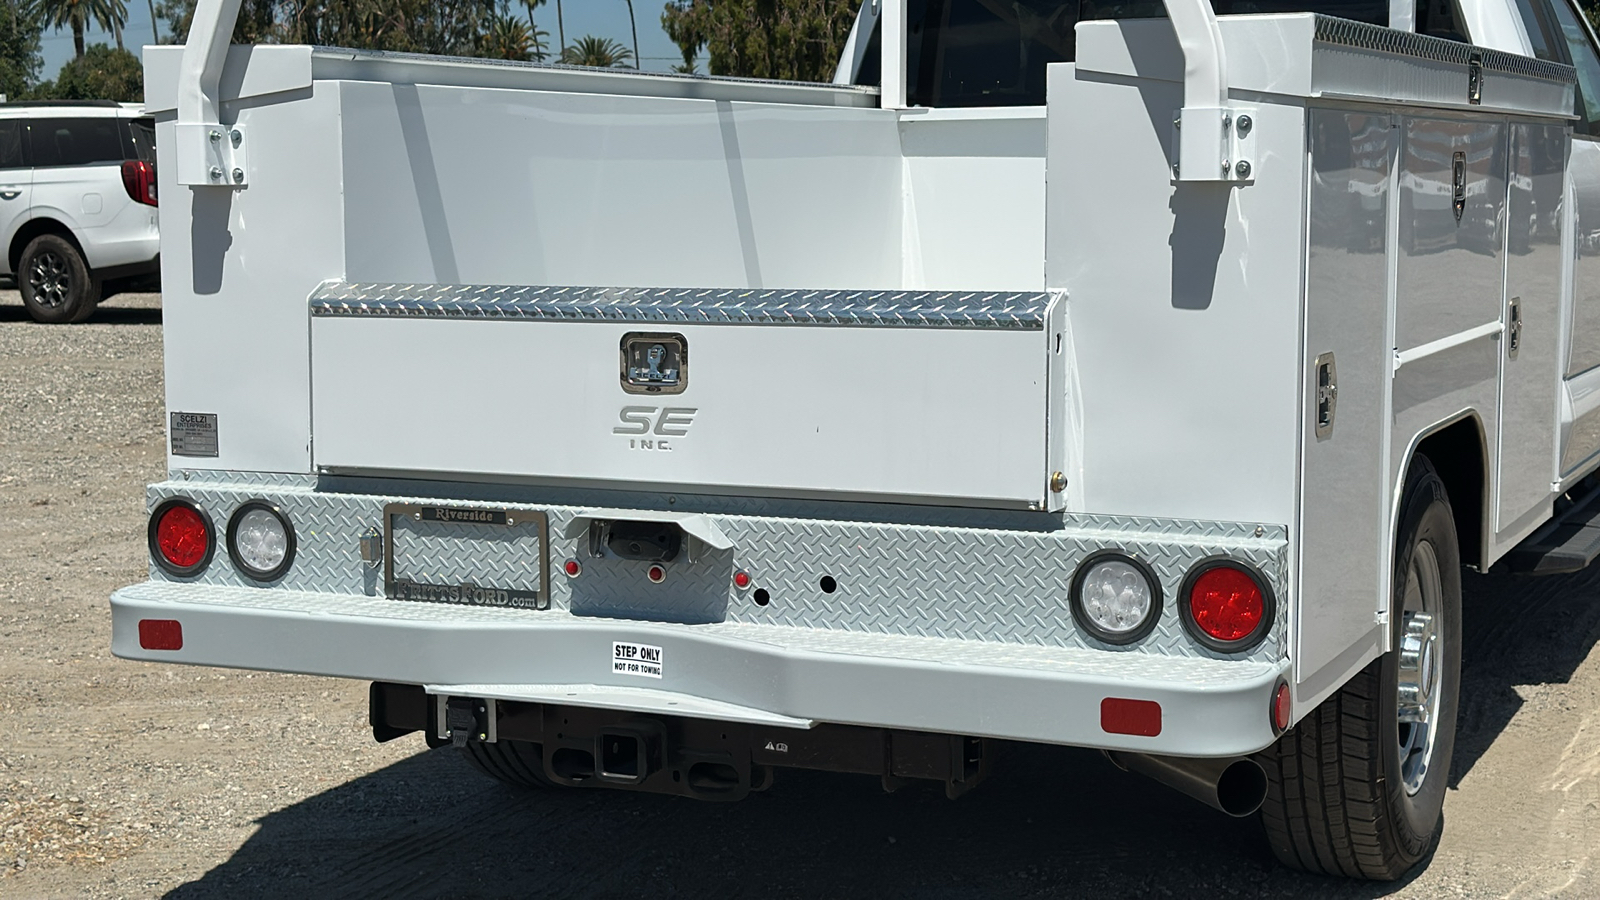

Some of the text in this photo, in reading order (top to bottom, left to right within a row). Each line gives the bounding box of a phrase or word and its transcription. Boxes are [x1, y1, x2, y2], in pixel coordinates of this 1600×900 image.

[180, 415, 207, 423] SCELZI
[612, 405, 698, 436] SE
[630, 439, 672, 450] INC.
[435, 508, 493, 522] Riverside
[615, 644, 660, 661] STEP ONLY
[614, 662, 660, 675] NOT FOR TOWING
